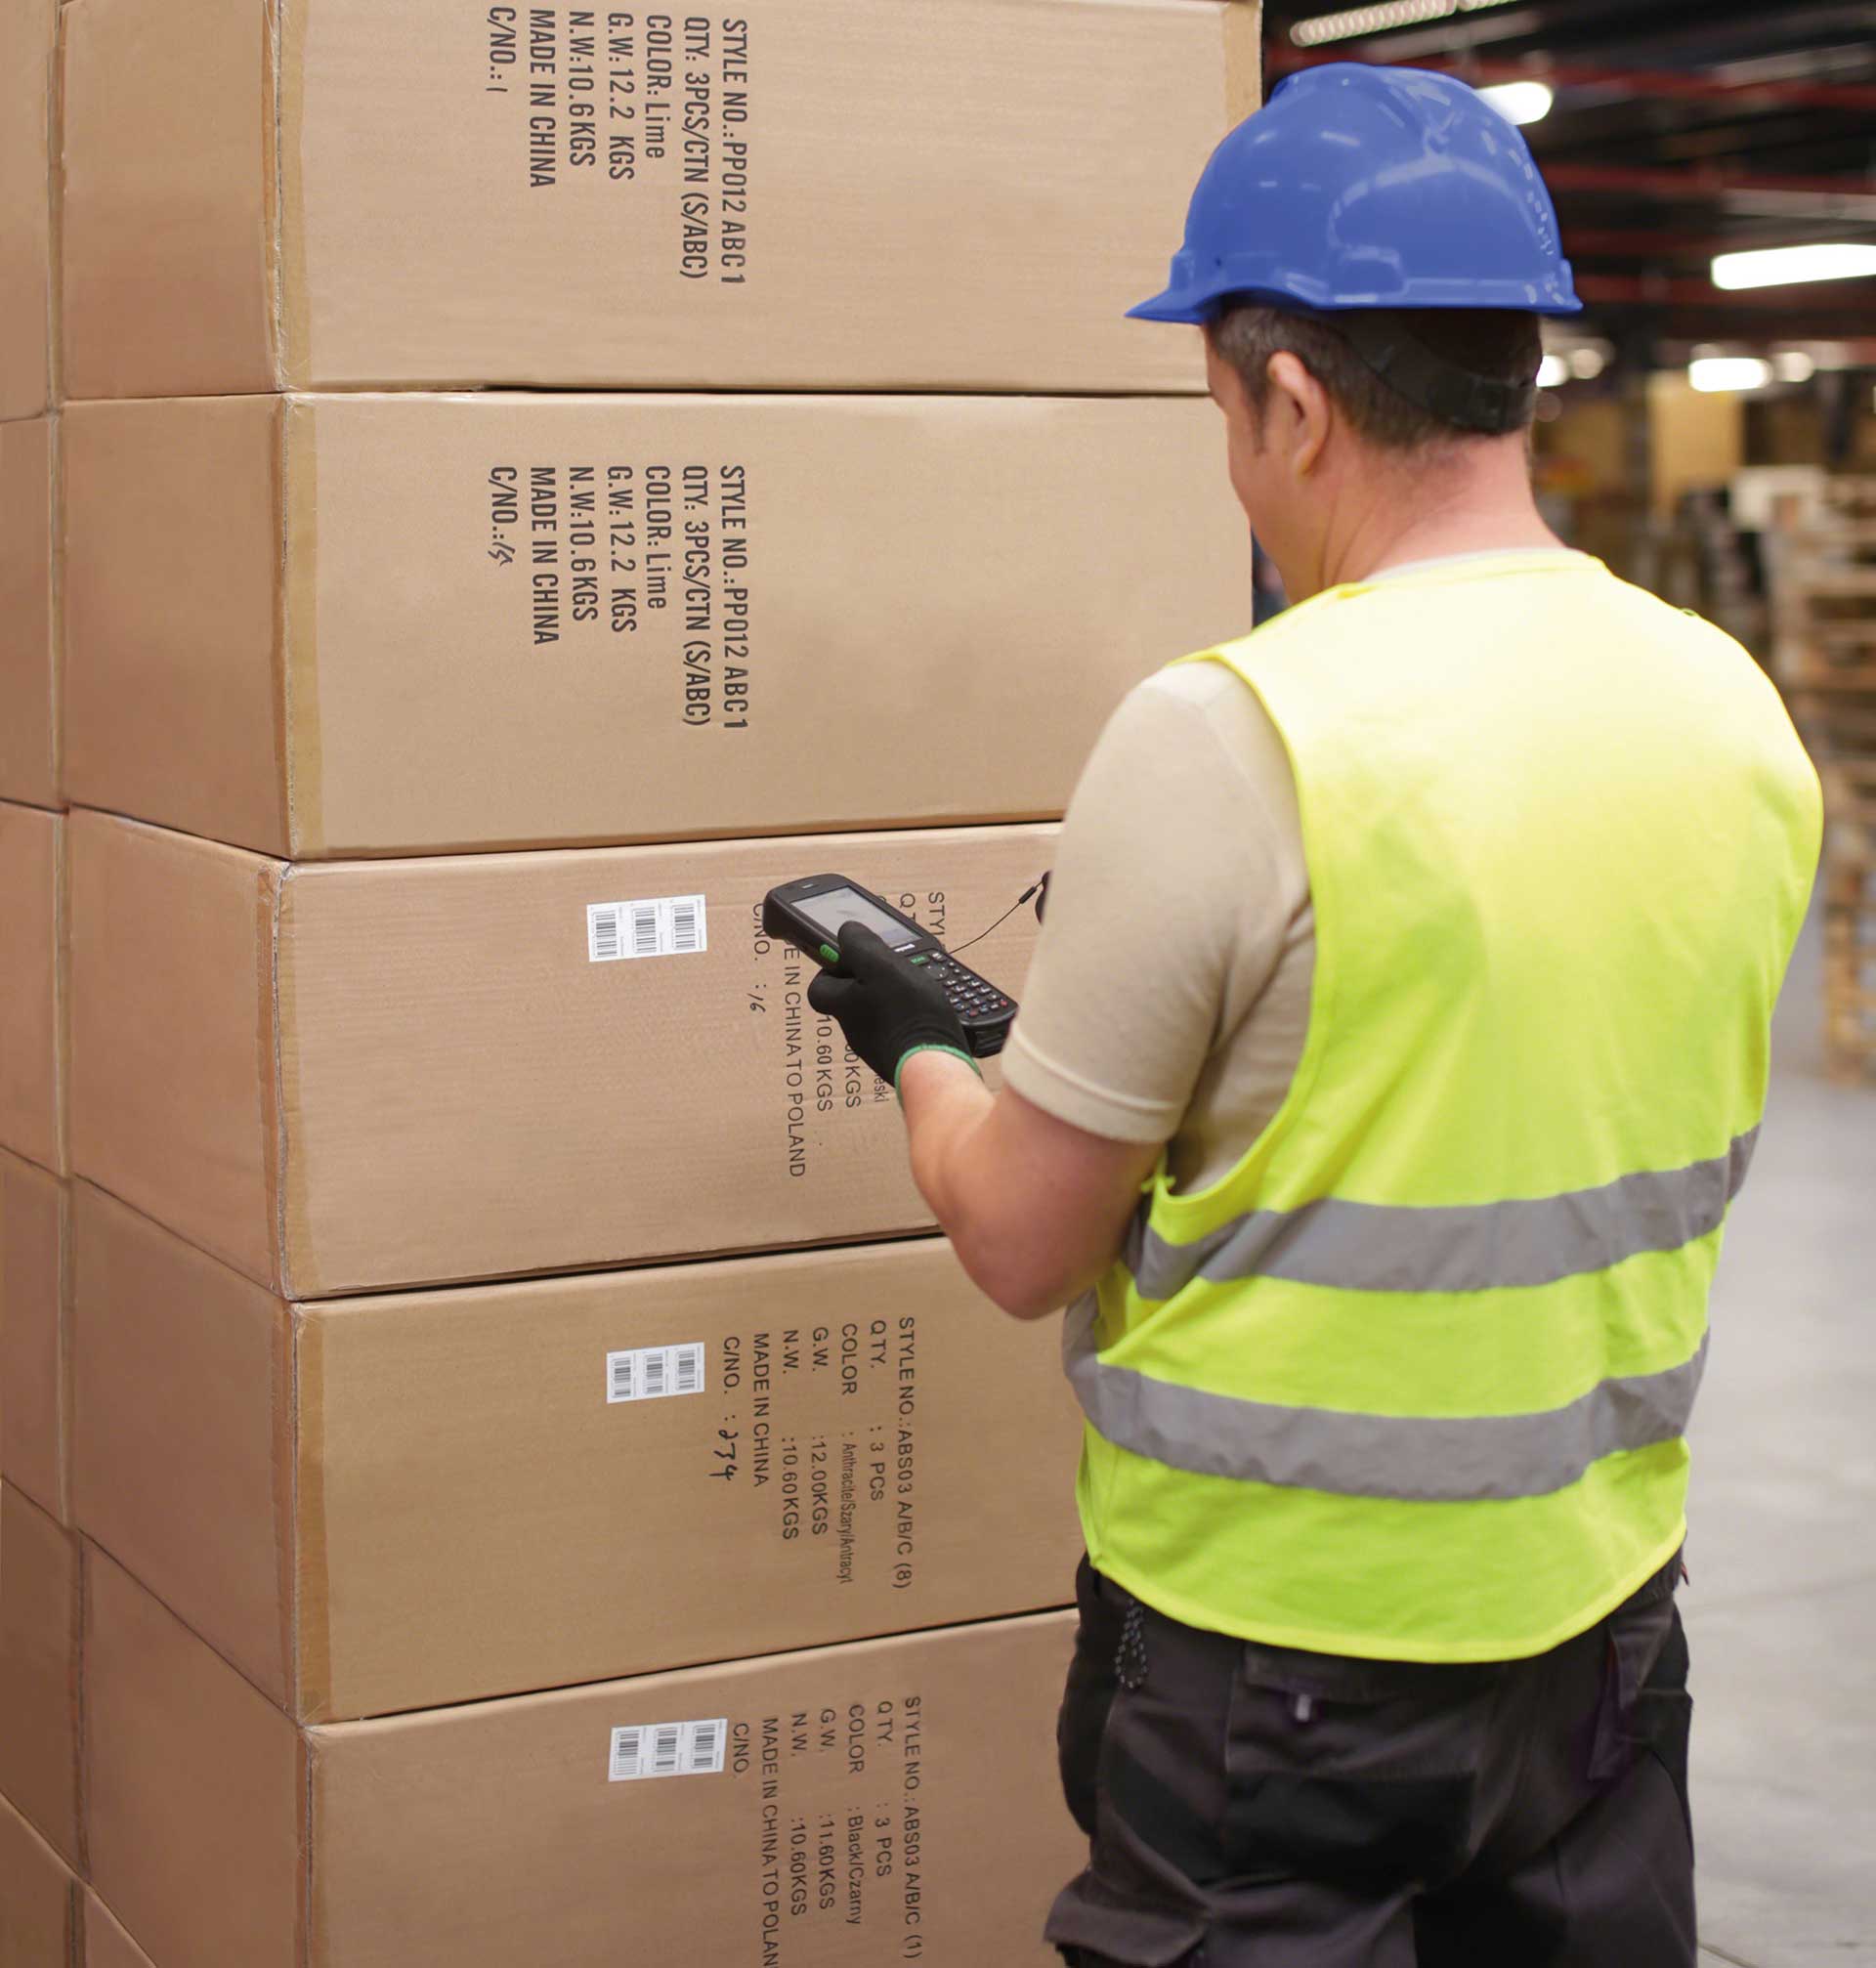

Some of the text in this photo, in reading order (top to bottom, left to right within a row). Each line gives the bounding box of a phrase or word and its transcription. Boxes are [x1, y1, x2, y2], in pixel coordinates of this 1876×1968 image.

[723, 19, 747, 82] STYLE
[530, 10, 556, 188] MADE IN CHINA
[646, 16, 672, 158] COLOR: Lime
[609, 136, 635, 180] KGS
[680, 18, 709, 278] QTY: 3PCS/CTN (S/ABC)
[721, 465, 746, 529] STYLE
[532, 467, 559, 645] MADE IN CHINA
[646, 465, 671, 609] COLOR: Lime
[612, 588, 637, 632] KGS
[683, 465, 711, 725] QTY: 3PCS/CTN (S/ABC)
[785, 965, 800, 985] IN
[785, 992, 802, 1056] CHINA
[786, 1059, 803, 1087] TO
[788, 1092, 807, 1177] POLAND
[724, 1337, 739, 1393] C/NO.
[784, 1331, 798, 1374] N.W.
[813, 1328, 829, 1372] G.W.
[842, 1324, 857, 1395] COLOR
[899, 1317, 915, 1380] STYLE
[754, 1333, 769, 1487] MADE IN CHINA
[871, 1442, 884, 1451] 3
[871, 1463, 885, 1501] PCS
[896, 1502, 912, 1556] A/B/C
[893, 1563, 912, 1589] (8)
[791, 1714, 807, 1756] N.W.
[849, 1704, 864, 1773] COLOR
[905, 1697, 921, 1755] STYLE
[763, 1719, 779, 1968] MADE IN CHINA TO POLAN
[875, 1818, 891, 1827] 3
[877, 1837, 891, 1876] PCS
[905, 1872, 920, 1925] A/B/C
[904, 1935, 922, 1958] (1)
